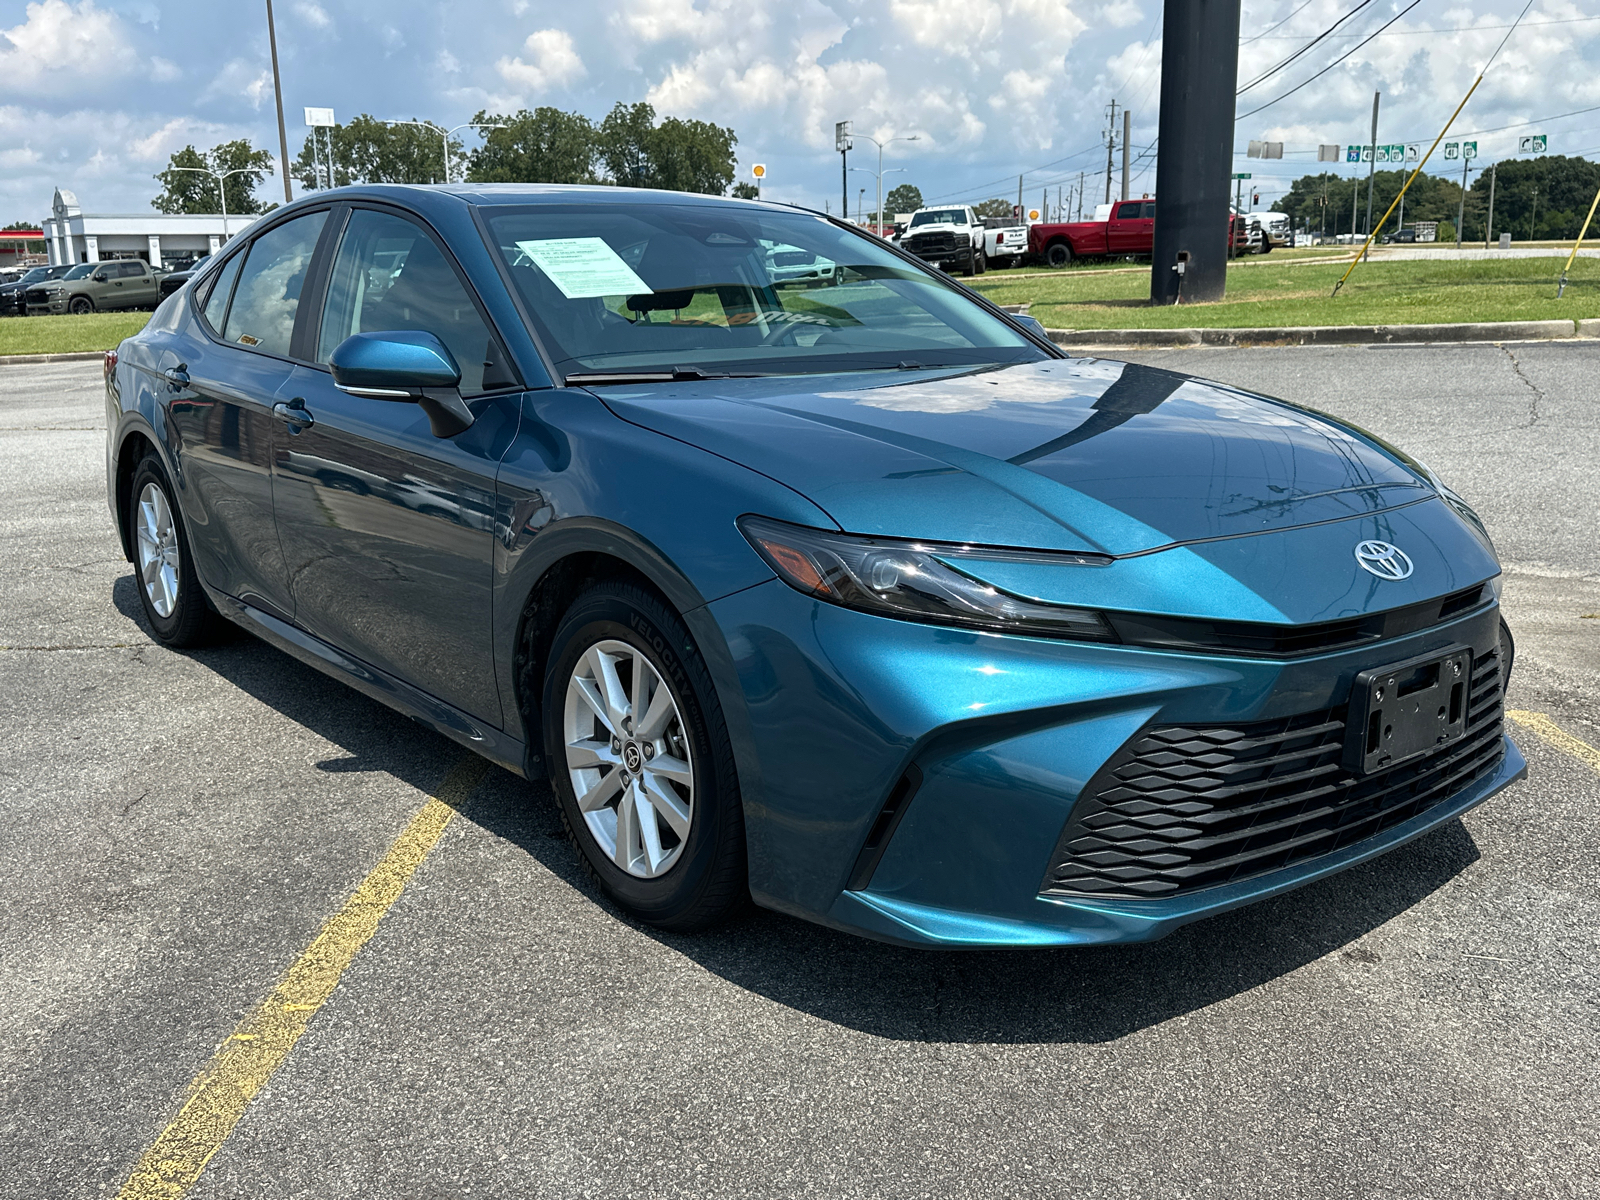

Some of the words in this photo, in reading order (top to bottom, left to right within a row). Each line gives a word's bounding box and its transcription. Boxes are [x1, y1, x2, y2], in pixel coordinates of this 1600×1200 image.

[1350, 152, 1358, 161] 75
[630, 612, 692, 697] VELOCITY
[688, 697, 709, 755] TOURING
